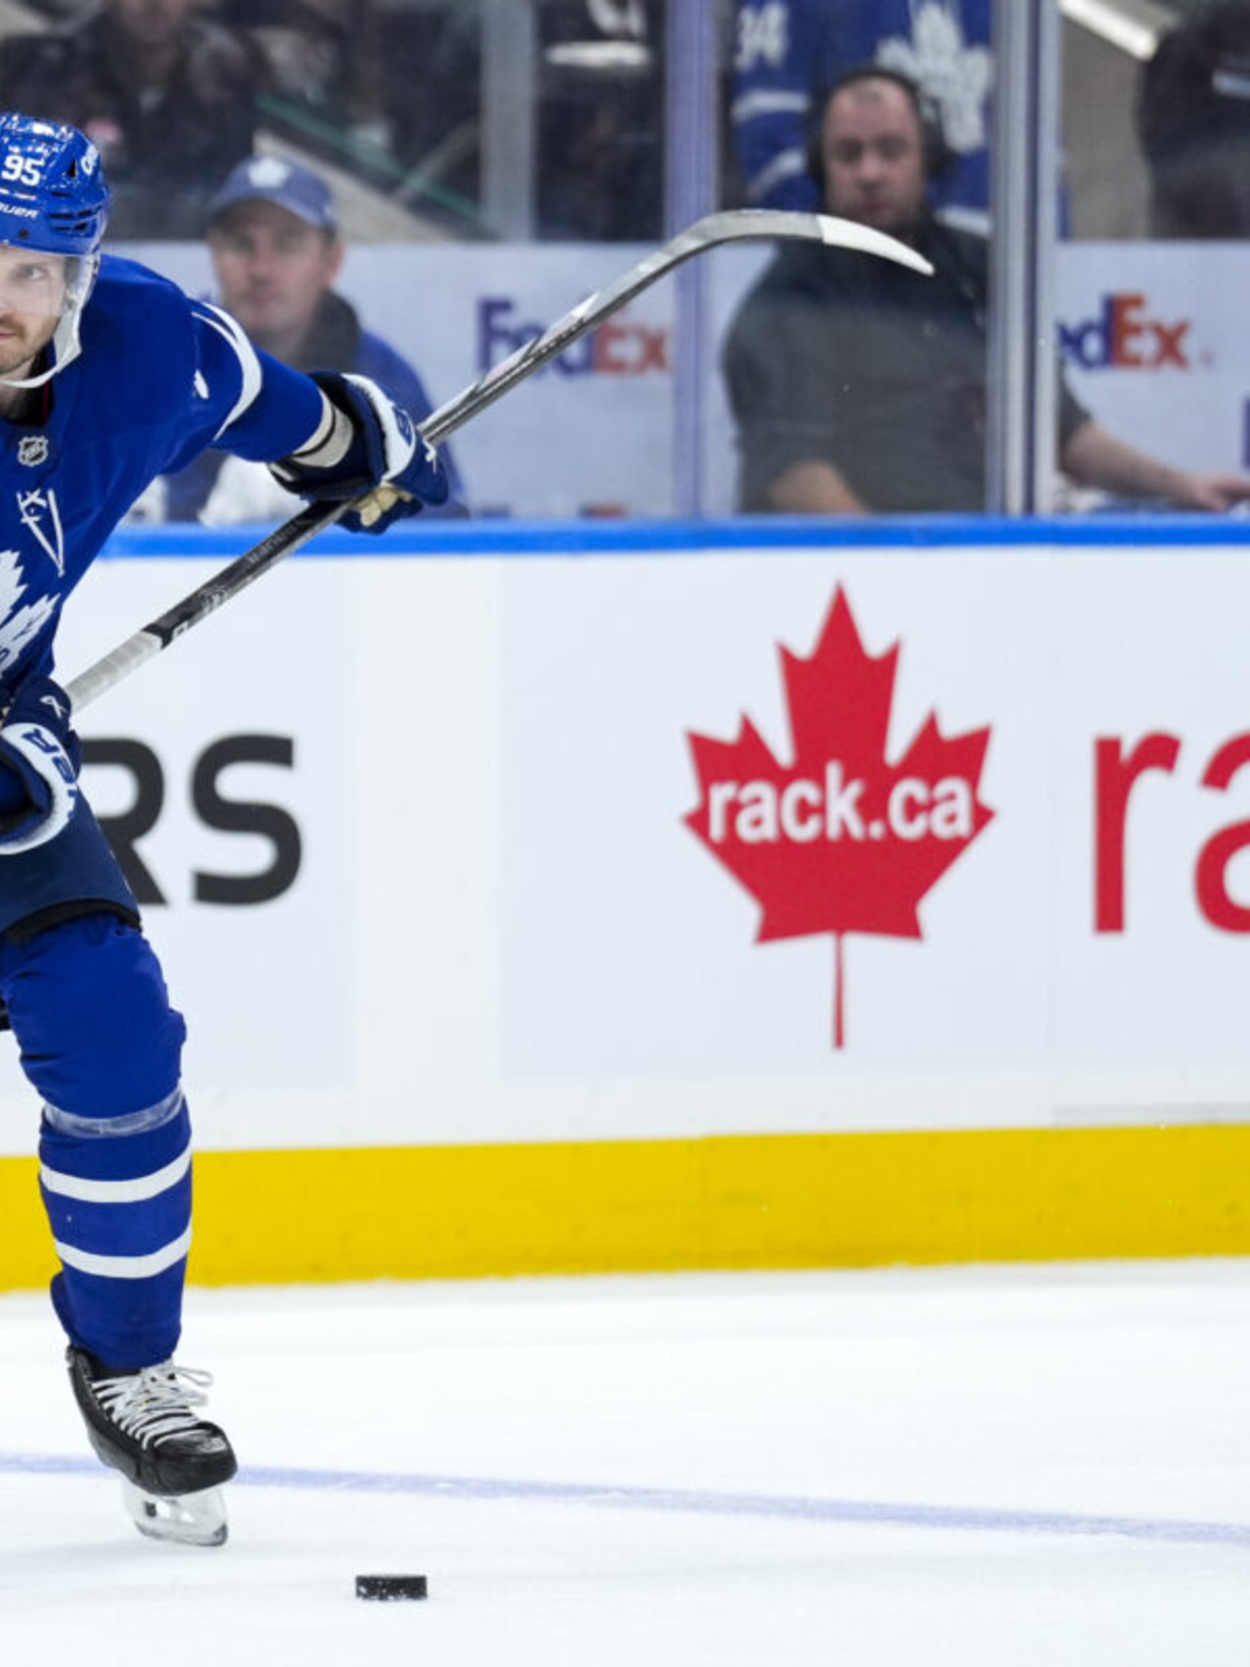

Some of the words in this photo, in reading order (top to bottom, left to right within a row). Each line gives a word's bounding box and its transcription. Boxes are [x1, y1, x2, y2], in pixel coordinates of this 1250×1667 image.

[1, 155, 45, 187] 95
[1056, 292, 1191, 373] dEx
[707, 759, 975, 842] rack.ca
